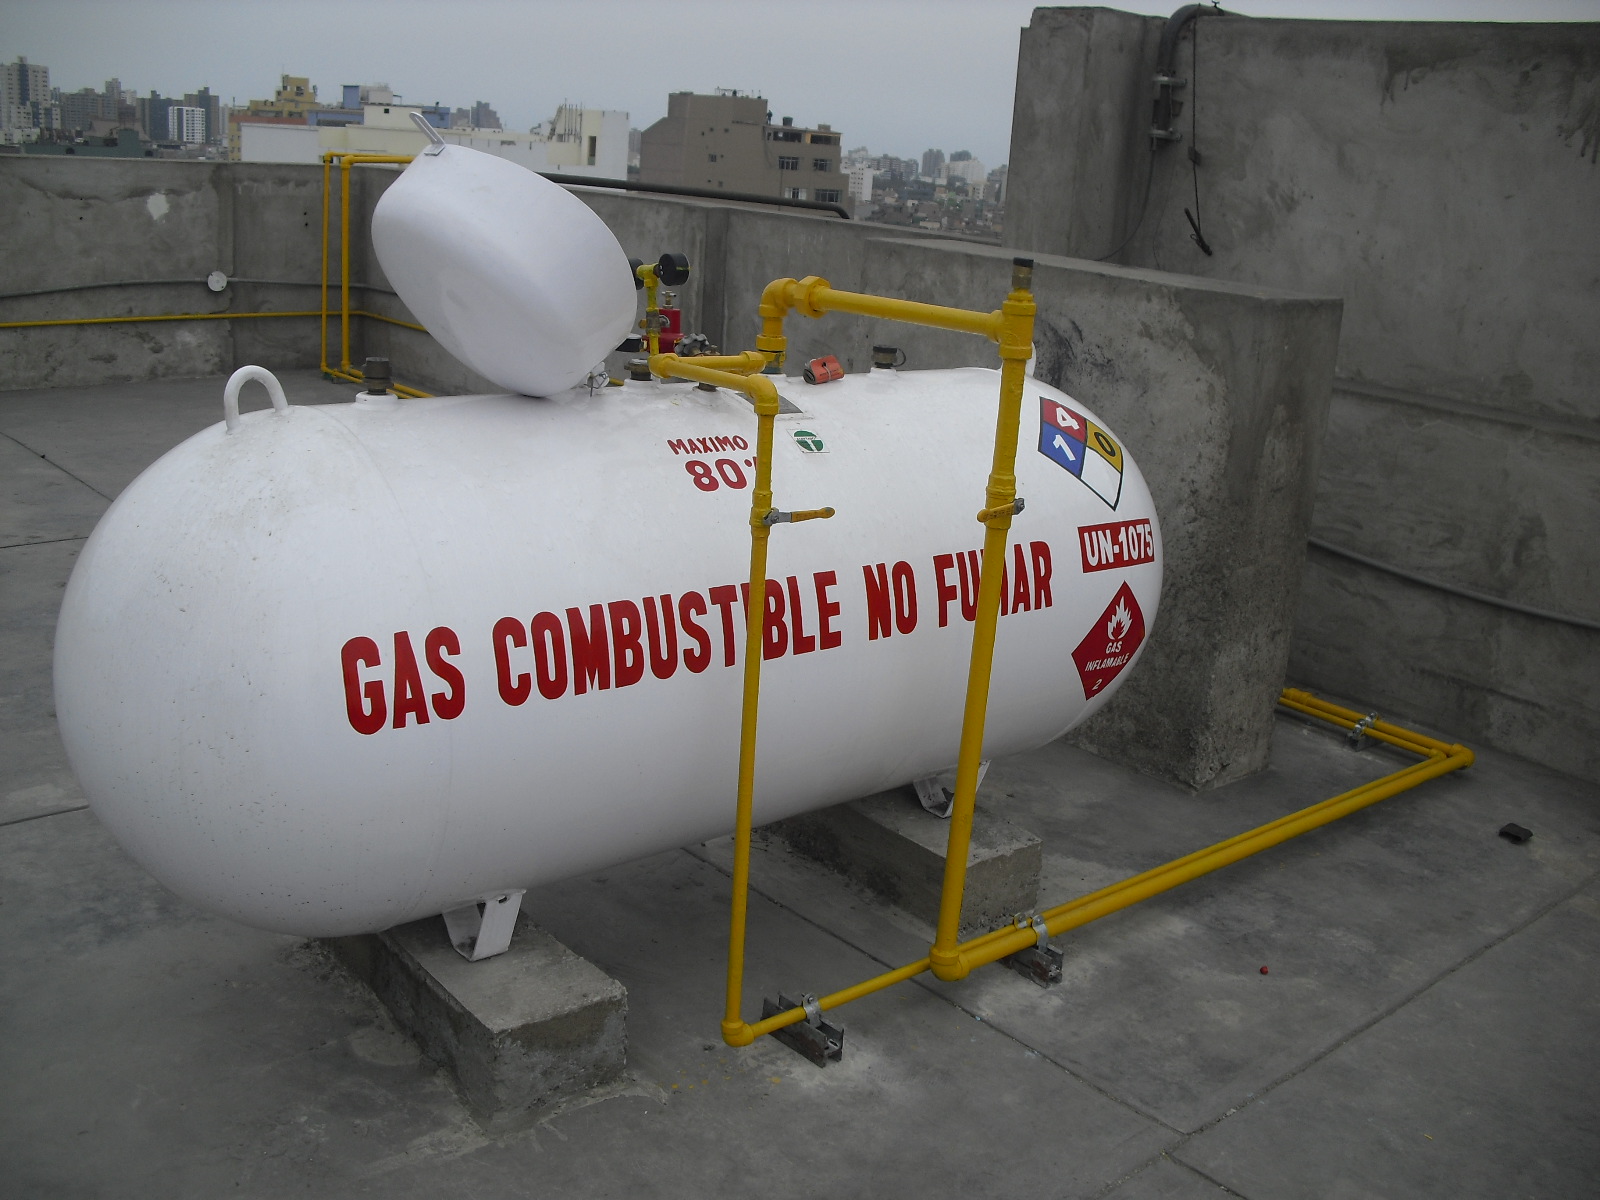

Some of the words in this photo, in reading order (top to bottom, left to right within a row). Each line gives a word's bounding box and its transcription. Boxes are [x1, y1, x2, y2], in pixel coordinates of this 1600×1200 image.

[1055, 406, 1080, 430] 4
[667, 435, 749, 455] MAXIMO
[1052, 434, 1076, 461] 1
[1093, 431, 1116, 457] 0
[685, 456, 758, 492] 80
[1083, 524, 1153, 566] UN-1075
[340, 626, 466, 735] GAS
[491, 570, 842, 706] COMBUSTBLE
[861, 560, 918, 641] NO
[1105, 640, 1123, 655] GAS
[1084, 652, 1130, 673] INFLAMABLE
[1091, 678, 1103, 691] 2
